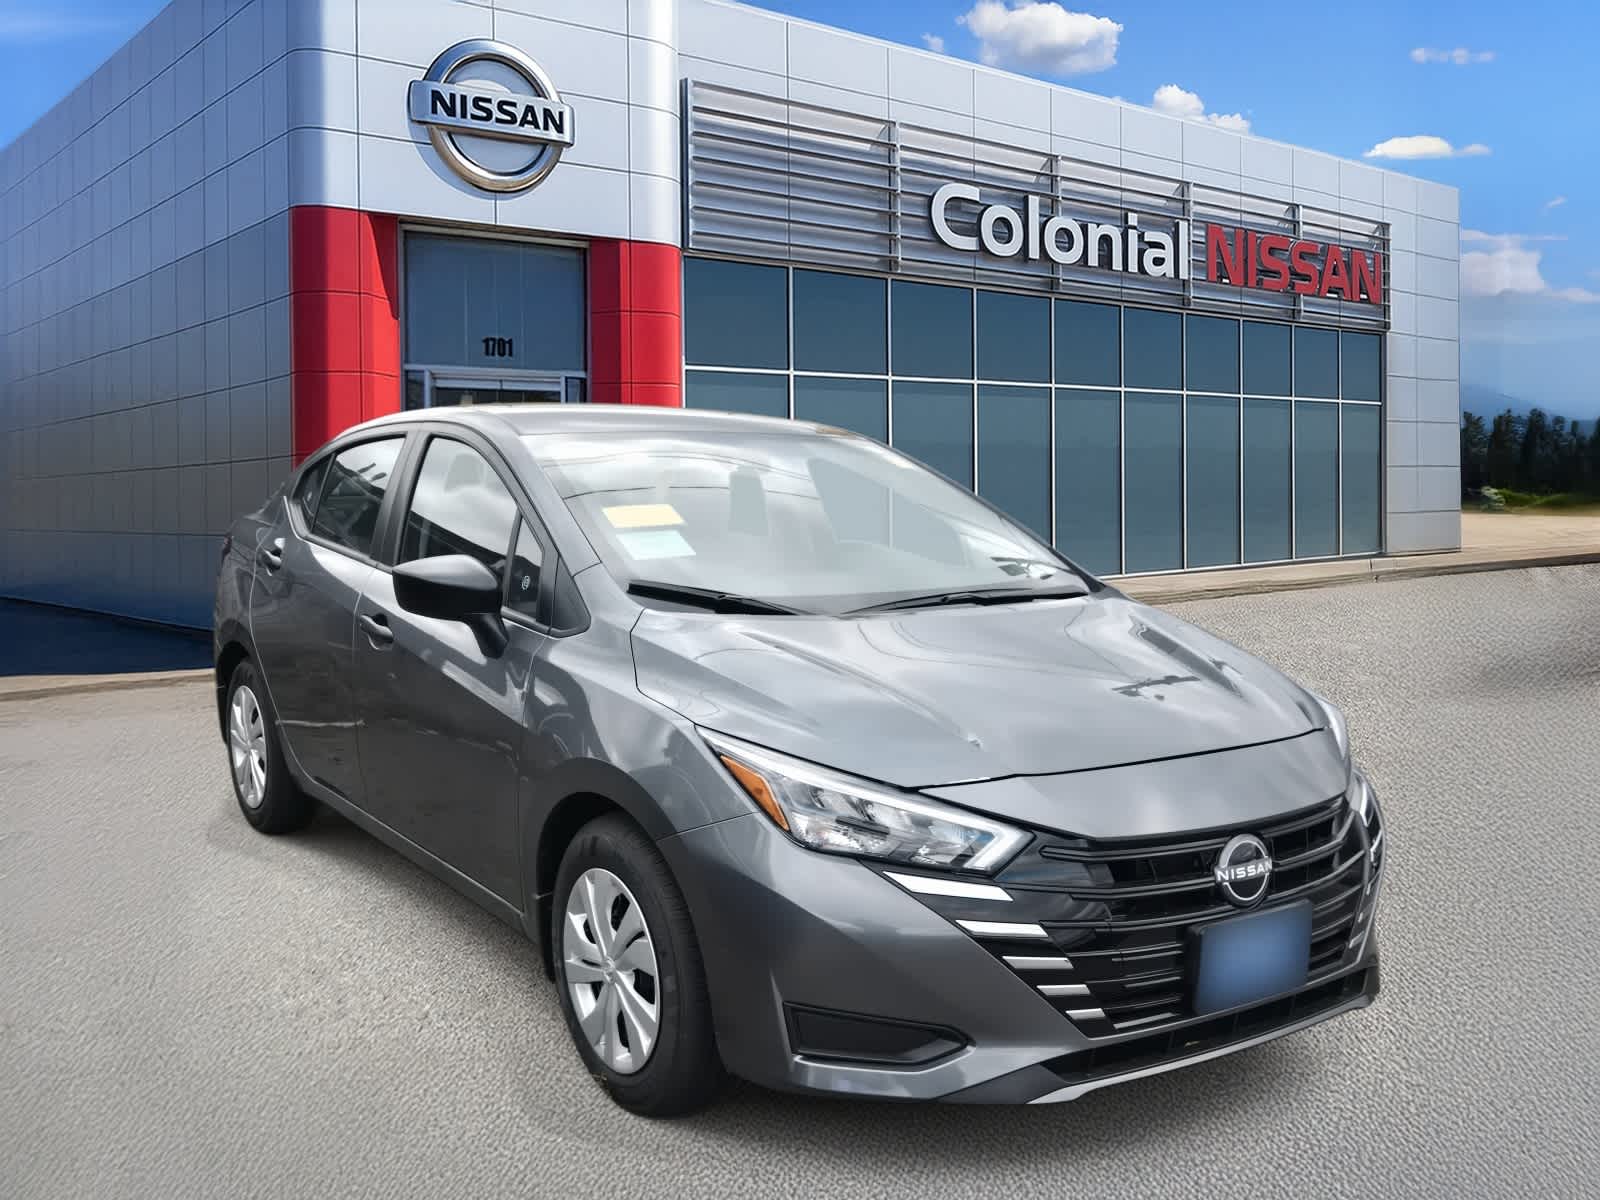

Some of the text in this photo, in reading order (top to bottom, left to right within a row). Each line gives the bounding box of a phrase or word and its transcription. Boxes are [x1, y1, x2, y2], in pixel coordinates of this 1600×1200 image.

[430, 89, 565, 134] NISSAN
[930, 183, 1383, 304] Colonial NISSAN
[482, 337, 513, 357] 1701
[1216, 859, 1273, 881] NISSAN
